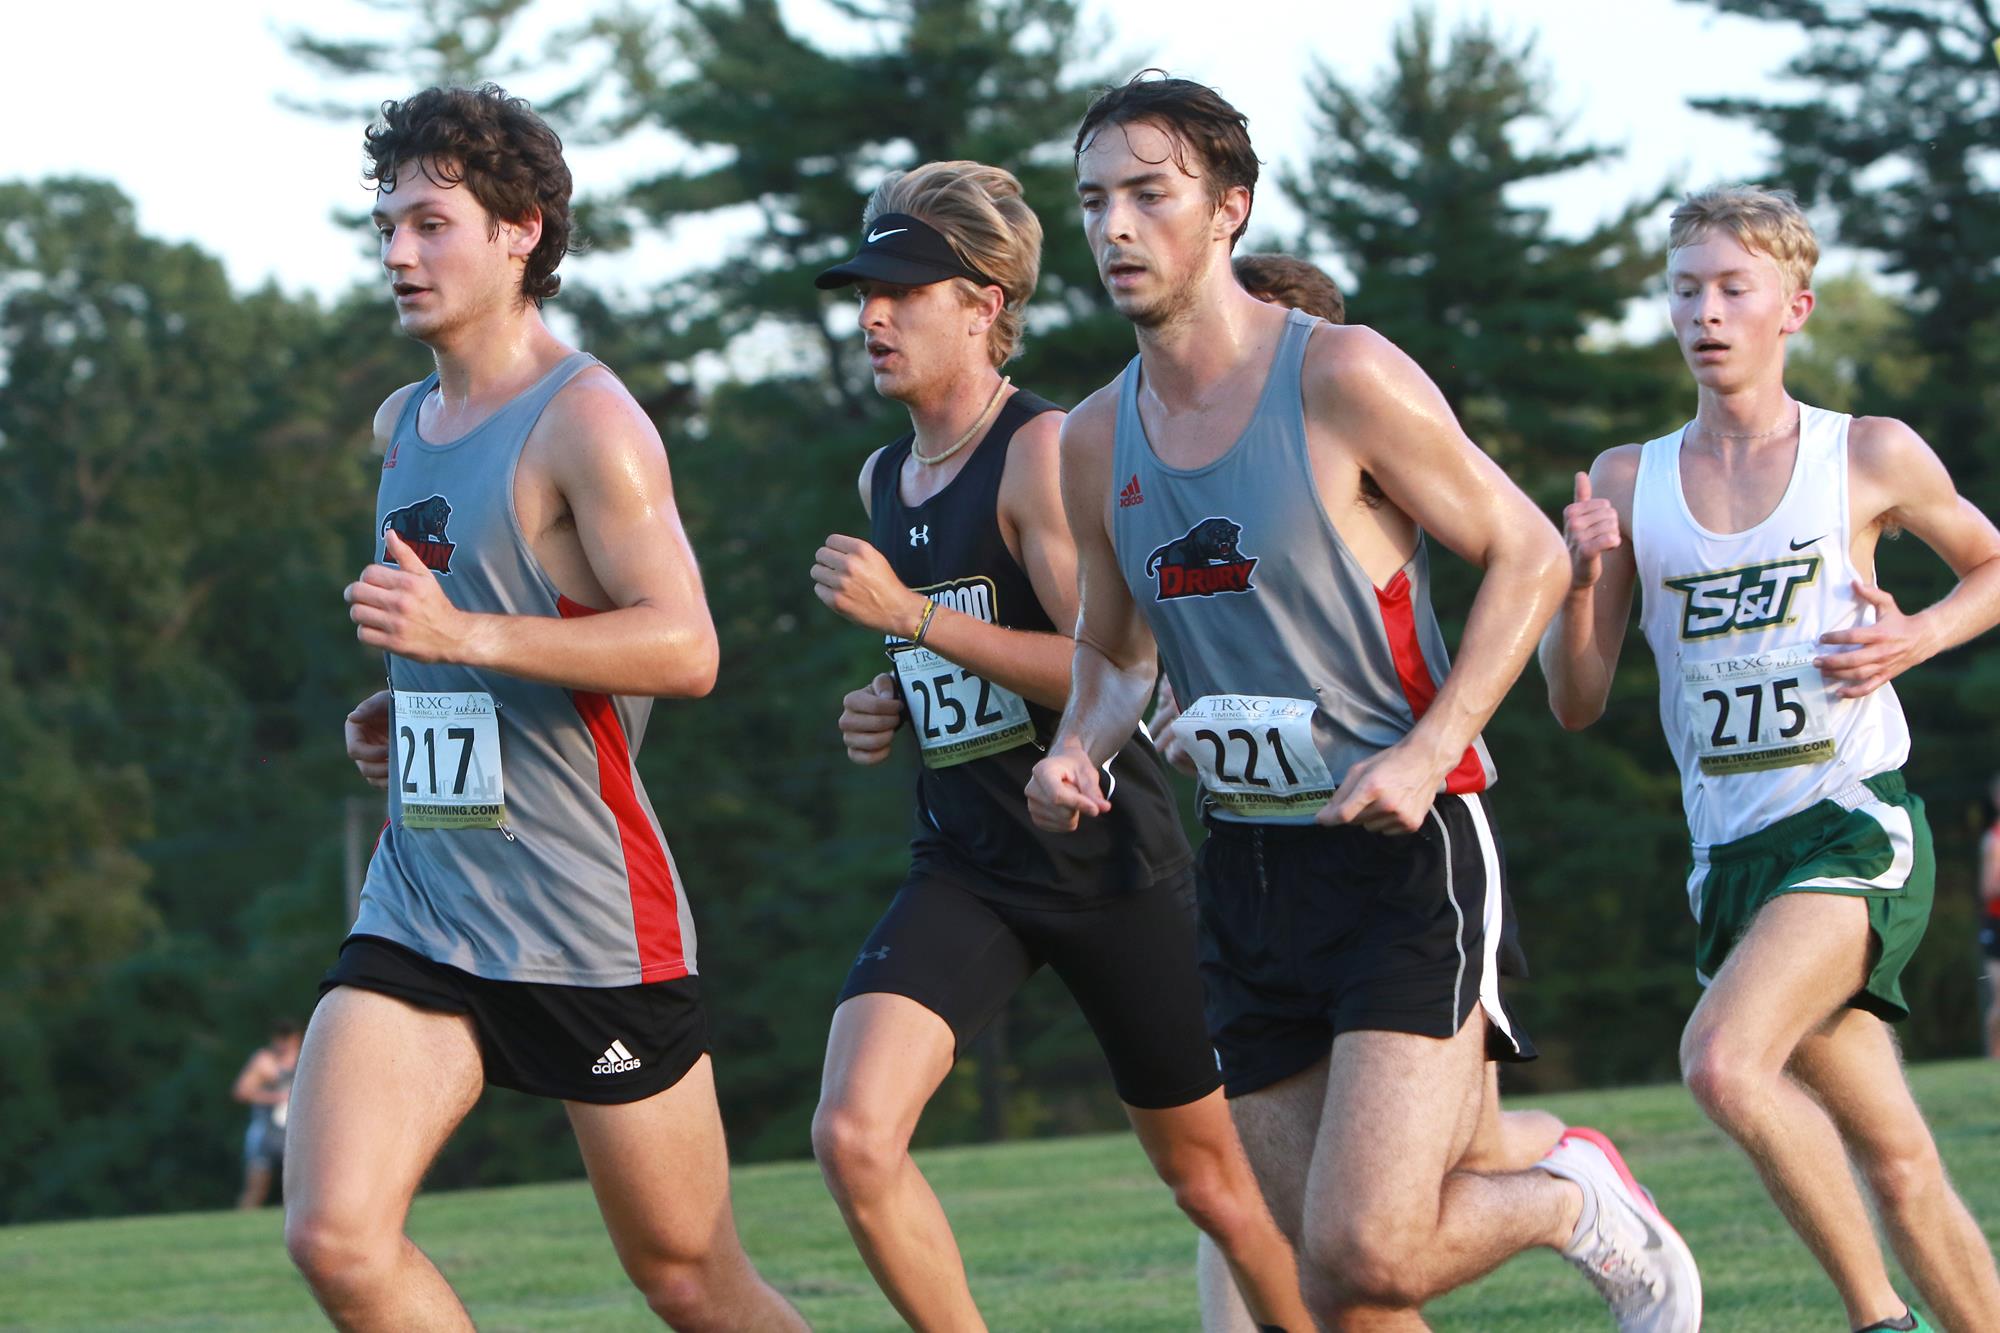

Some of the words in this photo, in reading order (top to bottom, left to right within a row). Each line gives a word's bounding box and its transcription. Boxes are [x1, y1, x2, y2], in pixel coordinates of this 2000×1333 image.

[1160, 562, 1251, 595] DRURY
[1676, 560, 1815, 636] S&T
[1710, 655, 1773, 674] TRXC
[406, 696, 452, 709] TRXC
[911, 669, 1003, 739] 252
[1208, 698, 1271, 712] TRXC
[1702, 677, 1806, 747] 275
[401, 725, 475, 795] 217
[1195, 727, 1299, 788] 221
[1702, 739, 1832, 765] WWW.TRXCTIMING.COM
[591, 1058, 642, 1075] adidas
